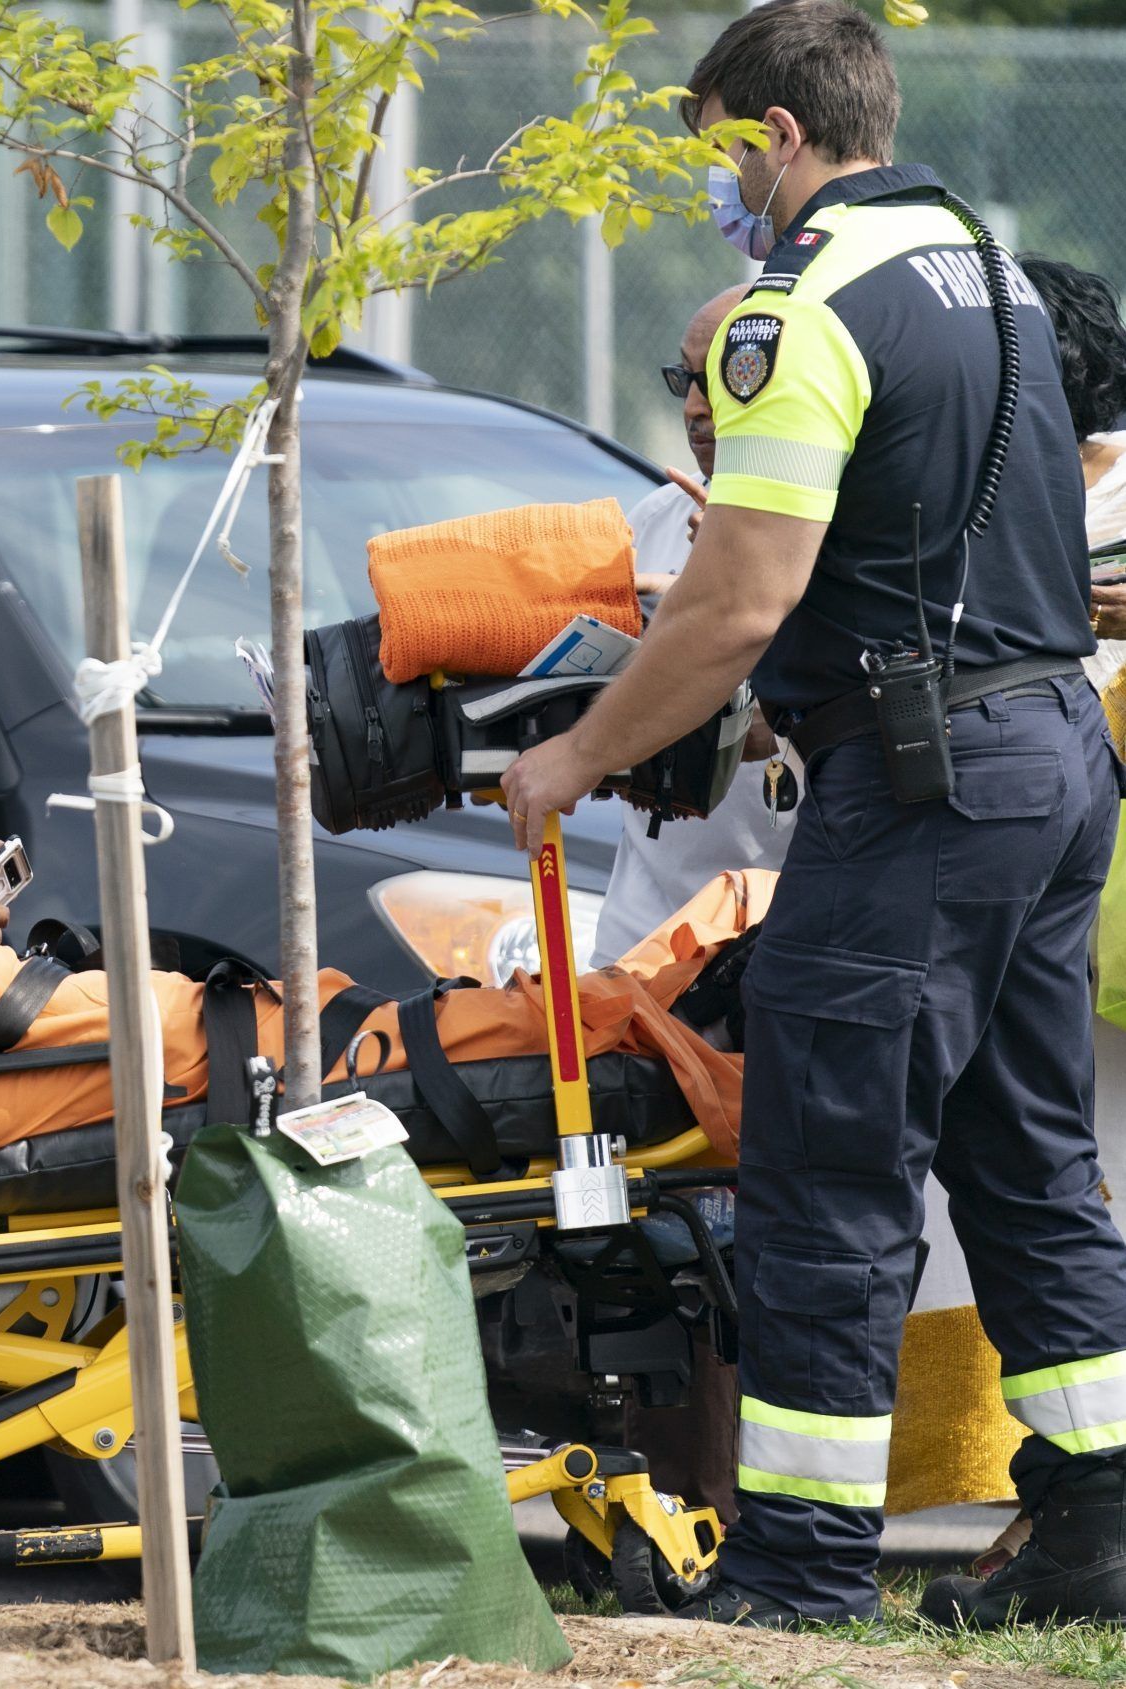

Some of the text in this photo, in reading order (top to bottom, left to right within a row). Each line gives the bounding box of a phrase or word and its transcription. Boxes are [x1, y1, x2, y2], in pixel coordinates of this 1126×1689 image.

[735, 319, 777, 327] TORONTO
[728, 325, 781, 337] PARAMEDIC
[731, 334, 773, 342] SERVICES
